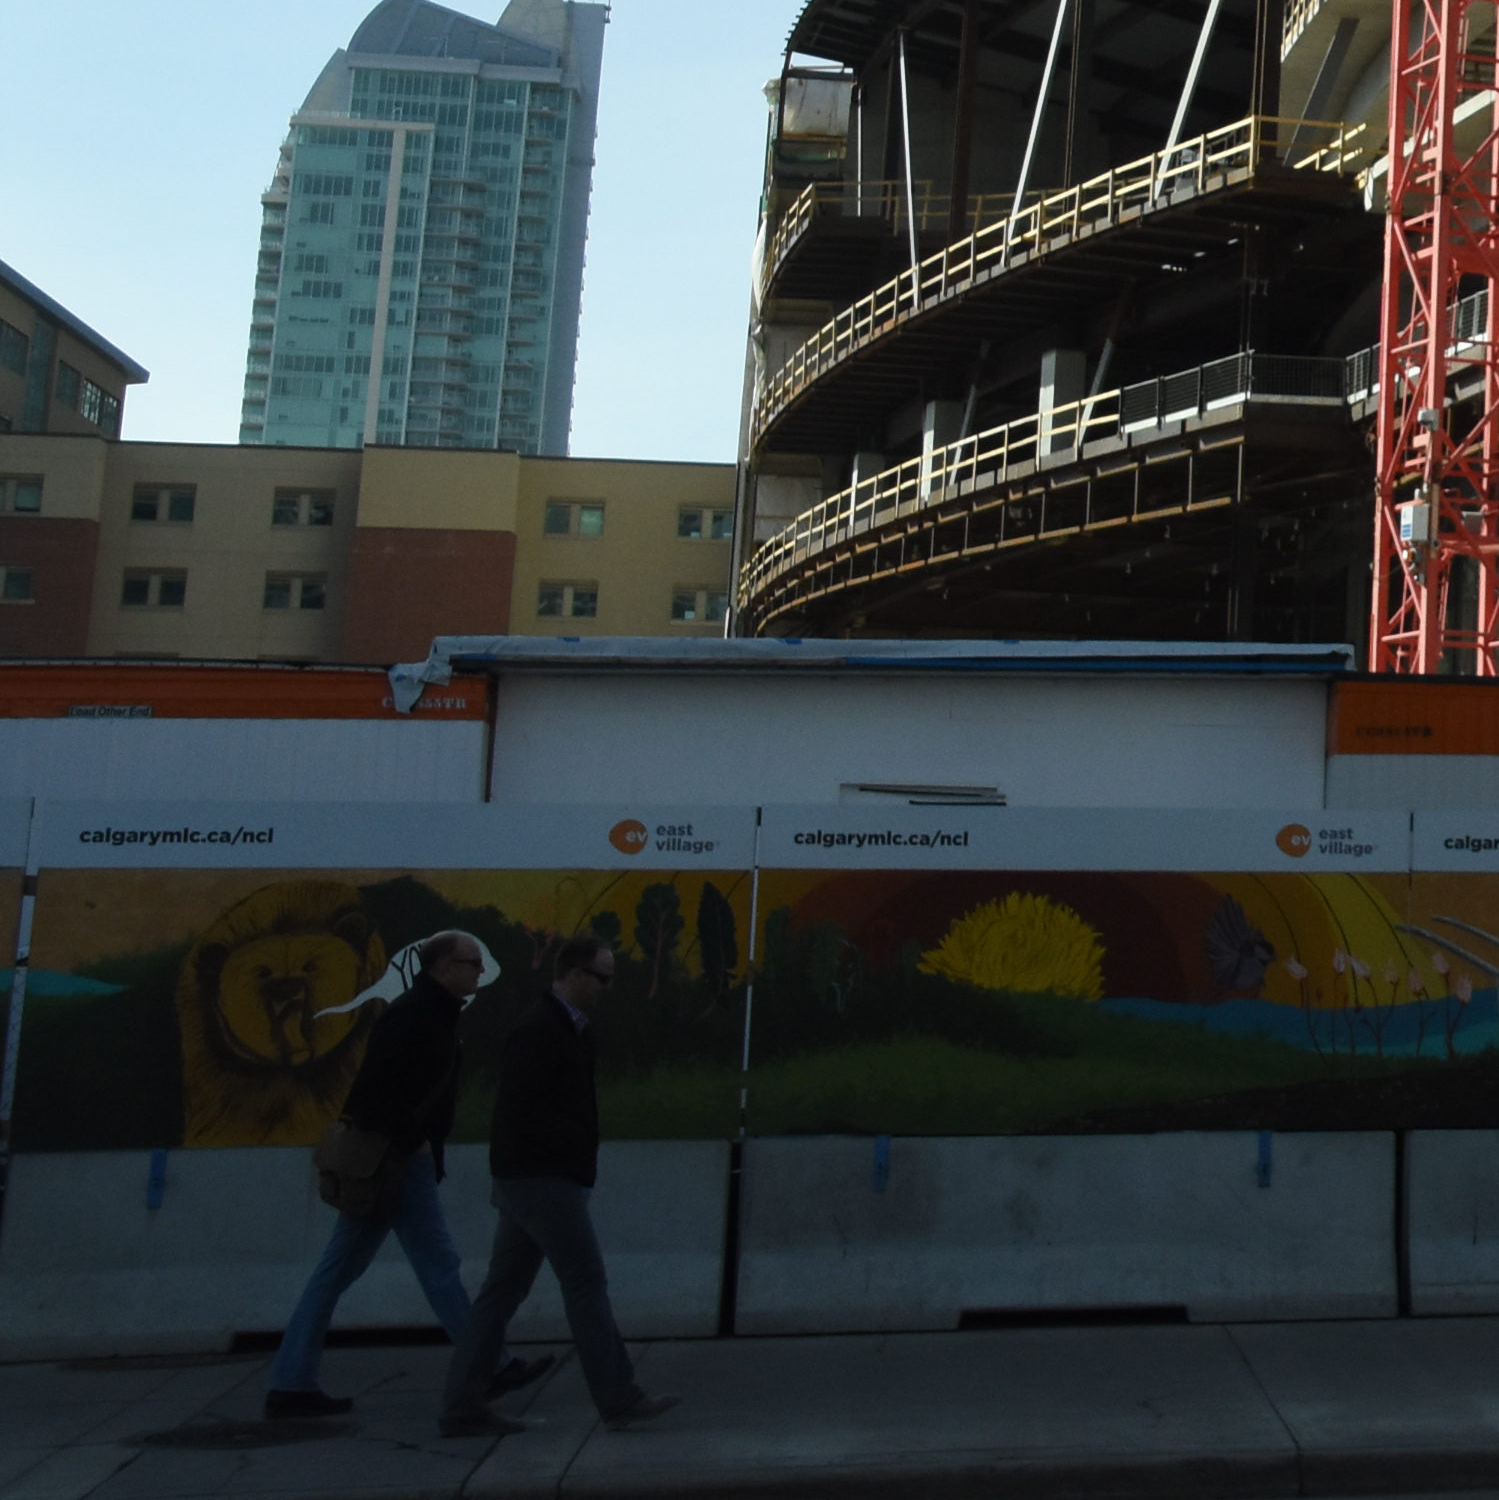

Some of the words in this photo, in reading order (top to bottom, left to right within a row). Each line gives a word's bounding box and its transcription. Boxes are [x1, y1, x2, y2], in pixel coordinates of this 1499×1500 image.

[79, 826, 274, 846] calgarymlc.ca/ncl
[625, 830, 648, 843] ev
[656, 823, 693, 836] east
[1318, 827, 1353, 839] east
[655, 837, 715, 854] village
[794, 829, 969, 848] calgarymlc.ca/ncl
[1290, 833, 1312, 846] ev
[1318, 840, 1373, 856] village
